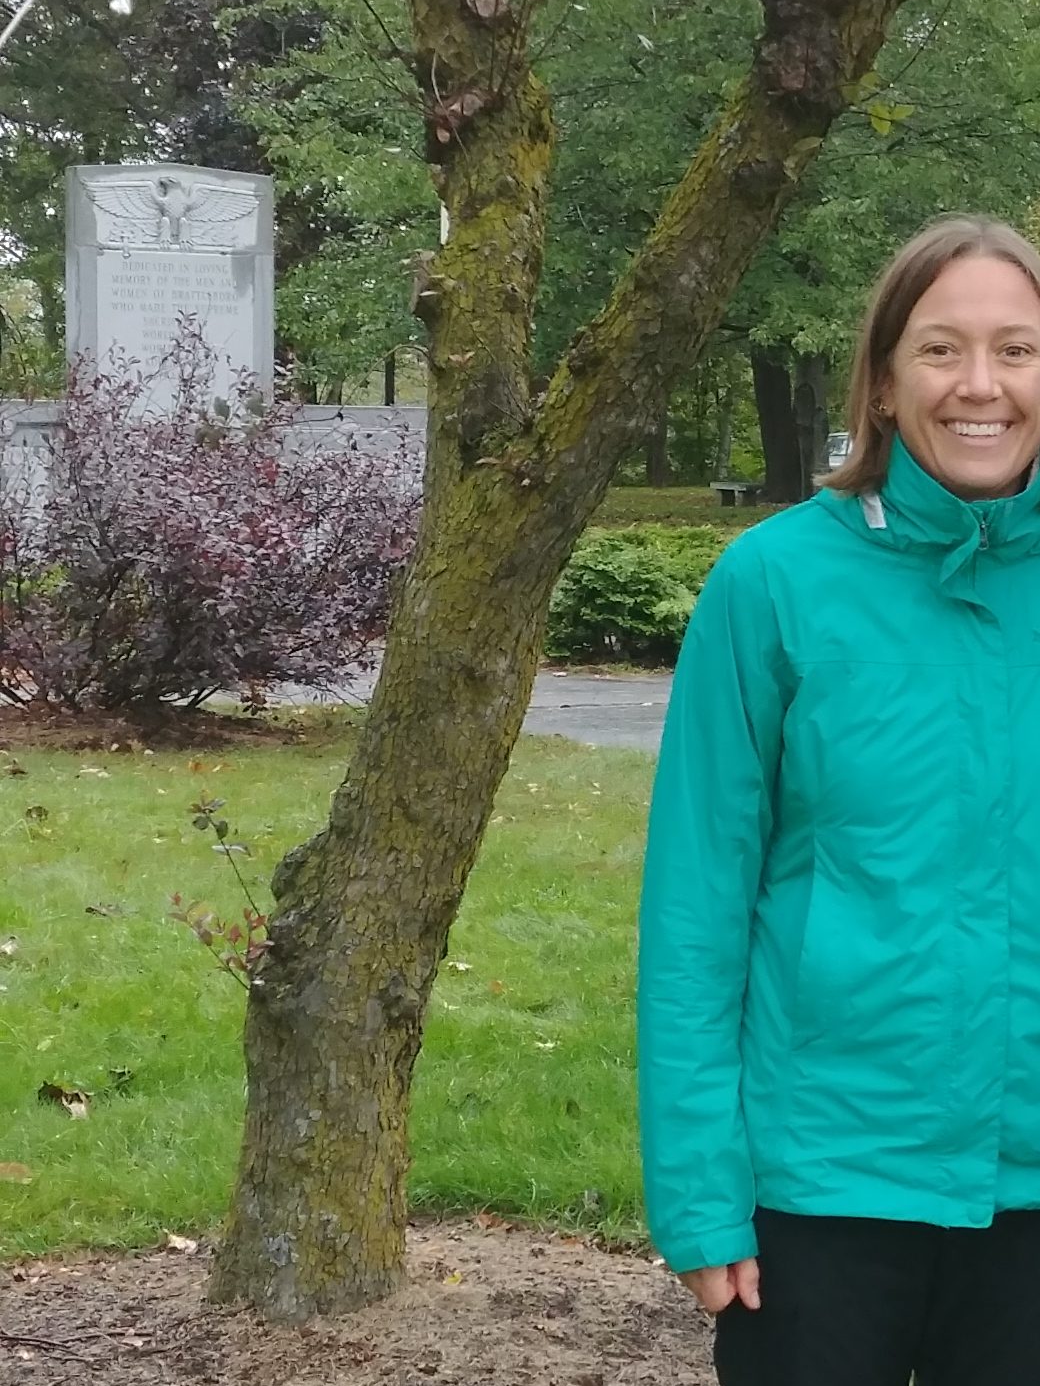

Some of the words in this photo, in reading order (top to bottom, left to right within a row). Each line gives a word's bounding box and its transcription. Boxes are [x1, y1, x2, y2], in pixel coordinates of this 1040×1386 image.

[122, 261, 174, 273] DEDICATED
[111, 274, 151, 285] MEMORY
[157, 275, 168, 286] OF
[173, 276, 191, 287] THE
[196, 277, 215, 288] MEN
[111, 287, 148, 299] WOMEN
[153, 289, 165, 300] OF
[111, 301, 134, 312] WHO
[140, 302, 165, 313] MADE
